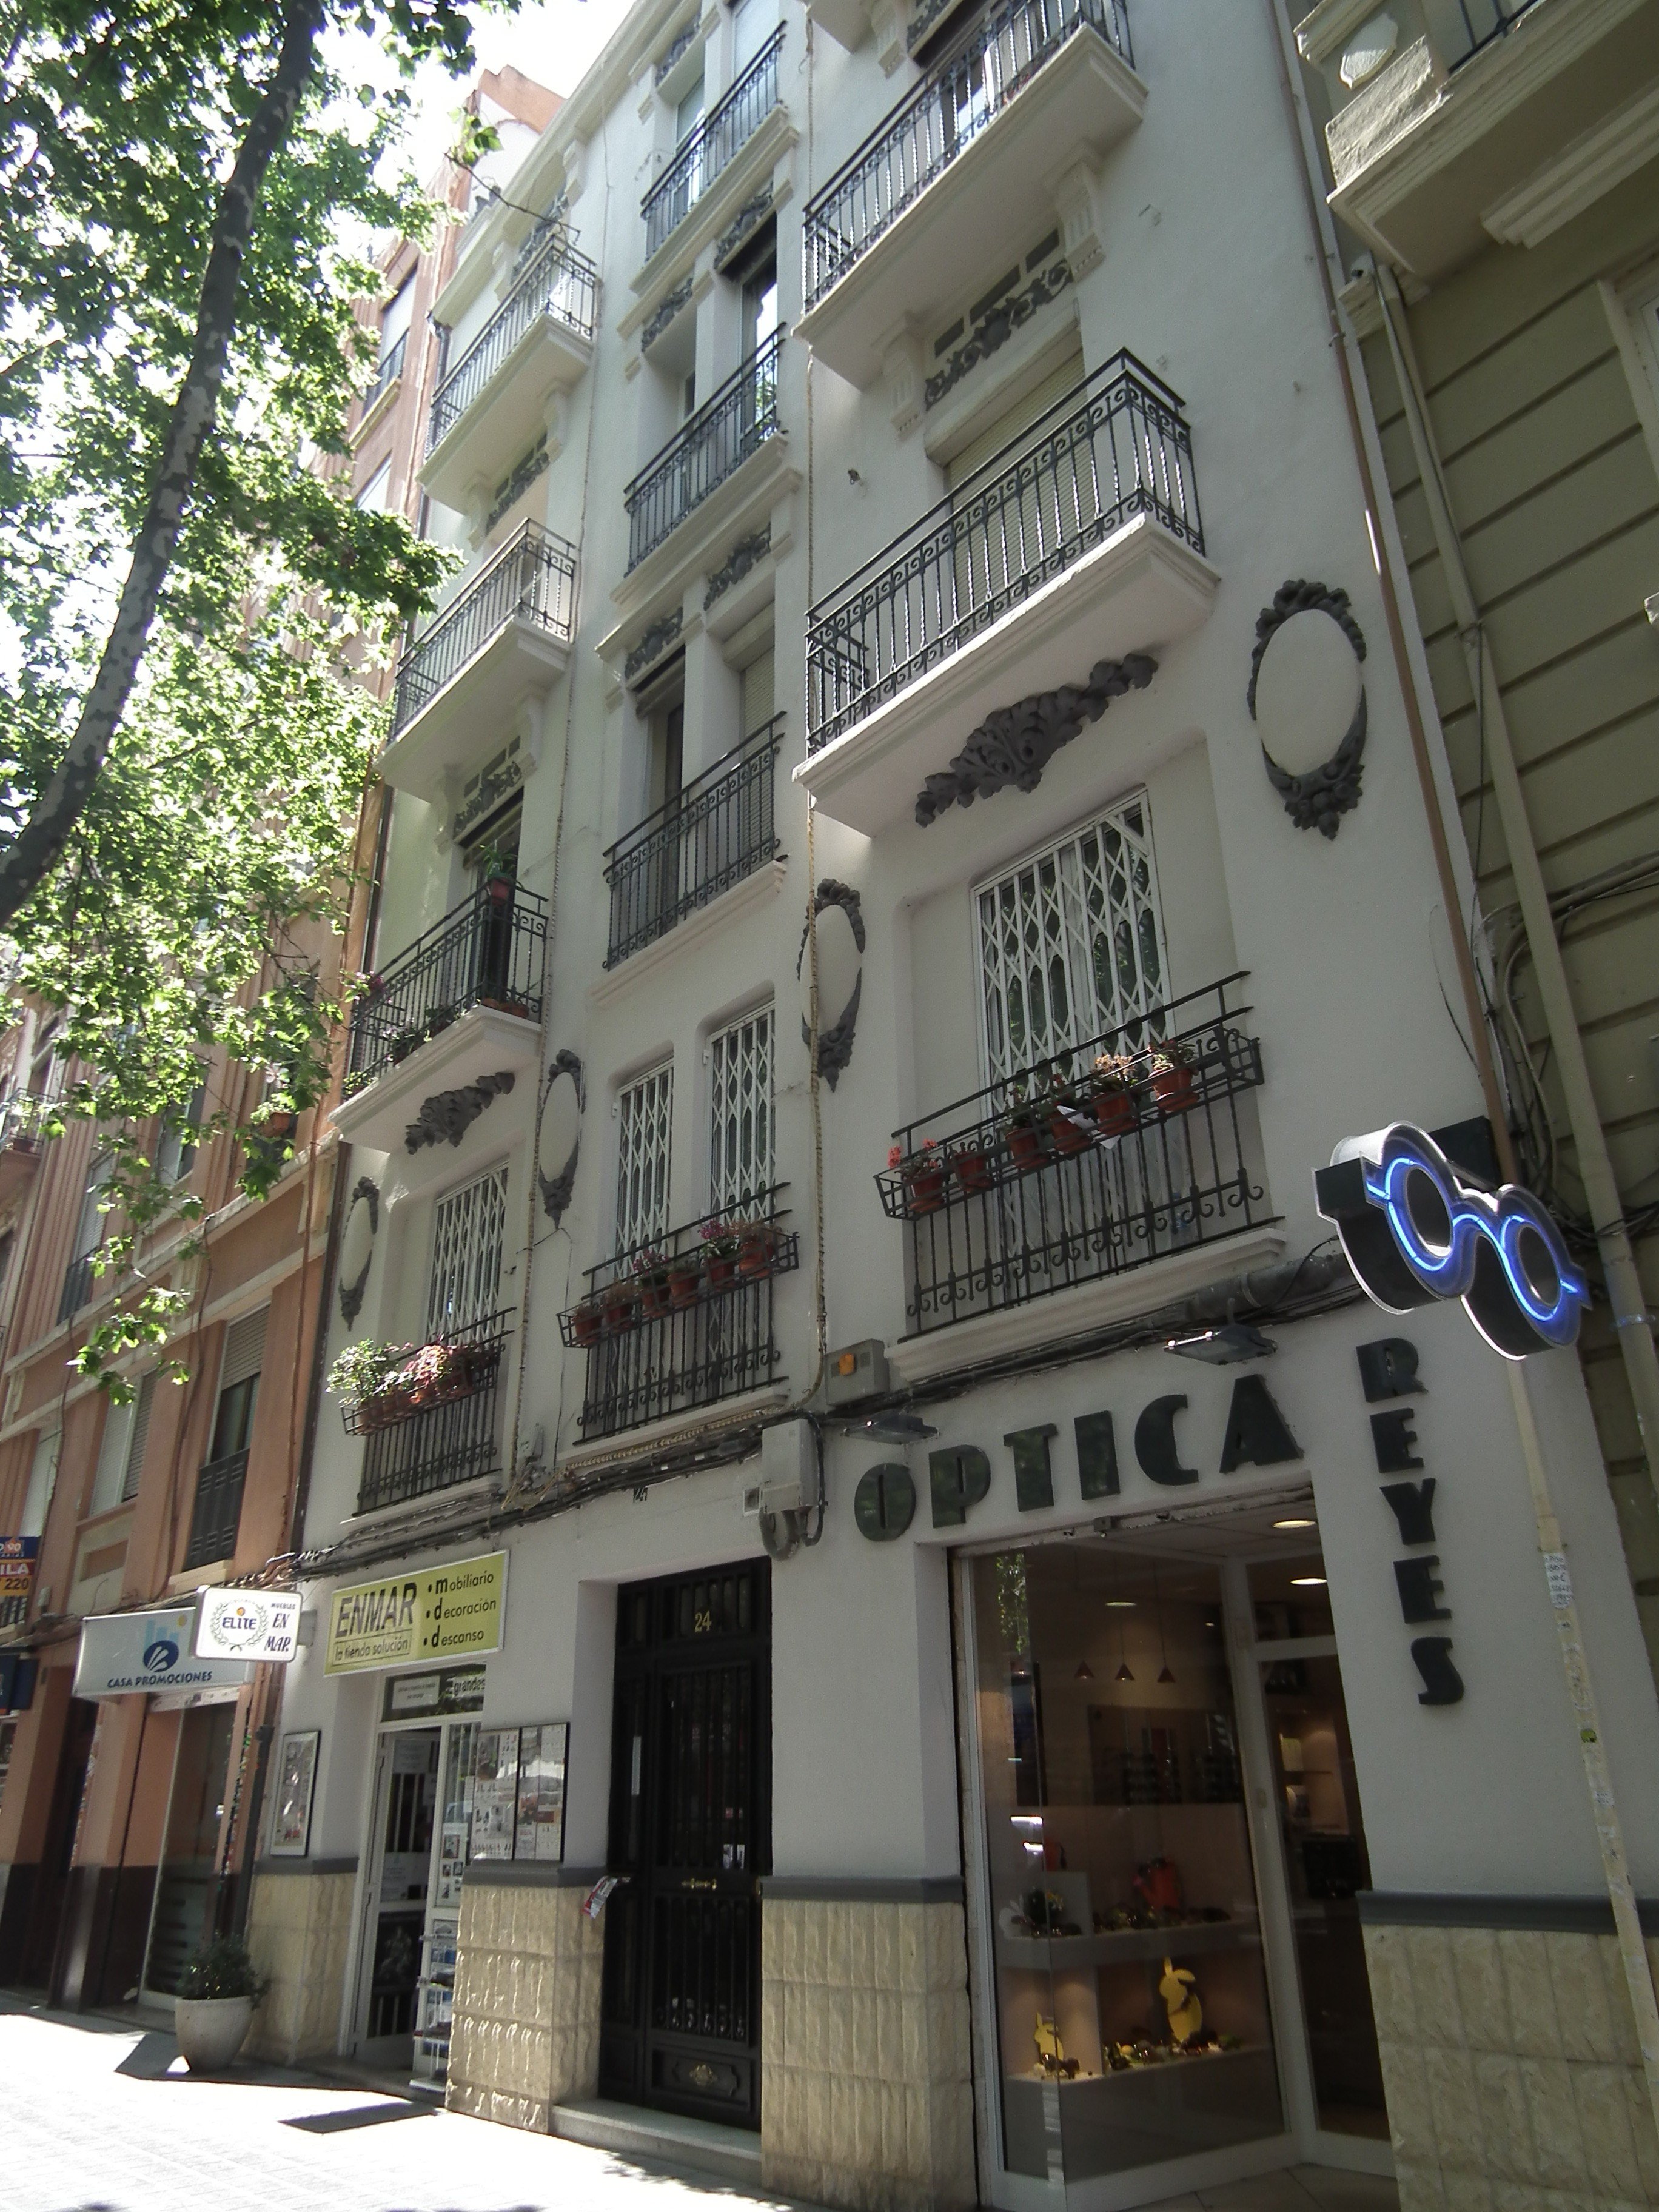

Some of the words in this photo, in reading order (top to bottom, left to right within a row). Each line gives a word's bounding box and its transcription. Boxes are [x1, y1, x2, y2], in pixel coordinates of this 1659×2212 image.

[854, 1374, 1305, 1541] OPTICA
[1356, 1338, 1464, 1705] REYES
[435, 1570, 494, 1594] mobiliario
[335, 1581, 417, 1638] ENMAR
[434, 1598, 497, 1620] decoración
[222, 1617, 256, 1631] ELITE
[694, 1610, 712, 1632] 24
[431, 1625, 484, 1647] descanso
[335, 1646, 343, 1662] la
[345, 1644, 370, 1661] tienda
[372, 1637, 408, 1657] solución
[107, 1677, 133, 1689] CASA
[135, 1670, 213, 1686] PROMOCIONES
